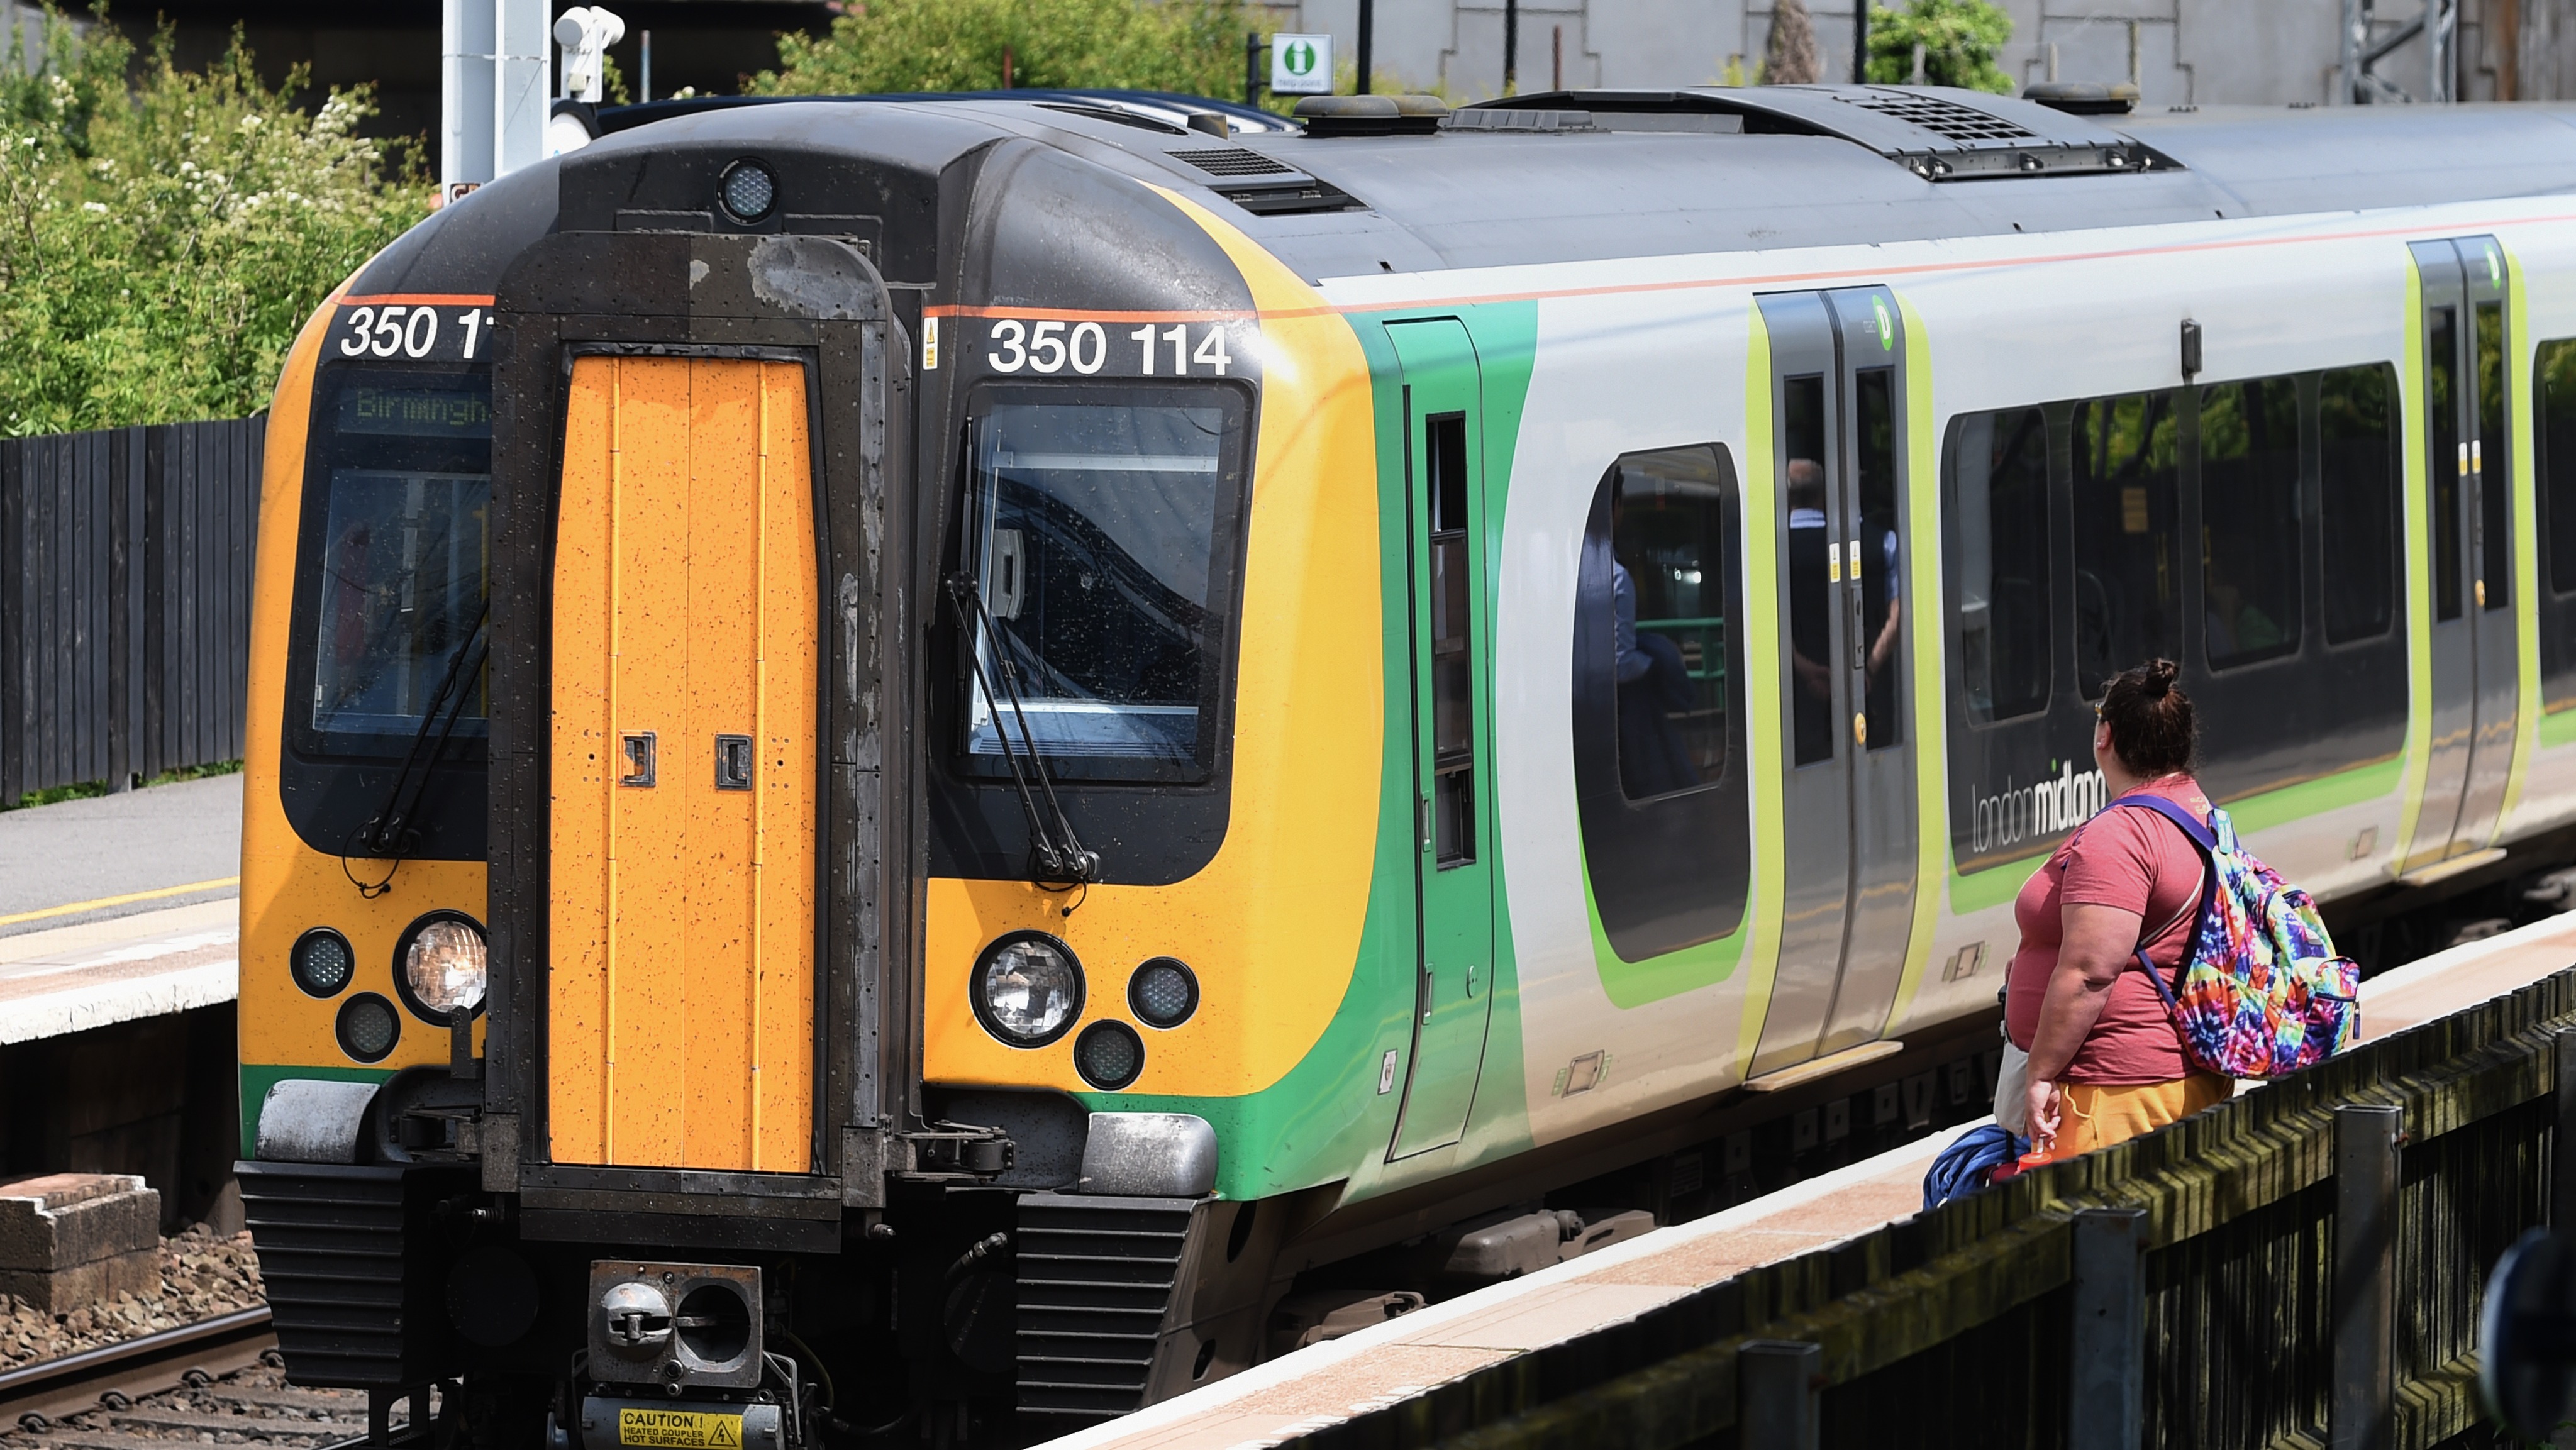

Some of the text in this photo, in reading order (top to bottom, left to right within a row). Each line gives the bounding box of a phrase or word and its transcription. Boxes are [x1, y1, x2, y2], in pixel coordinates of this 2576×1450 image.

[341, 306, 494, 358] 350 1
[988, 319, 1232, 375] 350 114
[358, 388, 492, 426] Birmingh
[624, 1413, 693, 1427] CAUTION
[624, 1427, 704, 1438] HEATED COUPLER
[624, 1434, 705, 1446] HOT SURFACES
